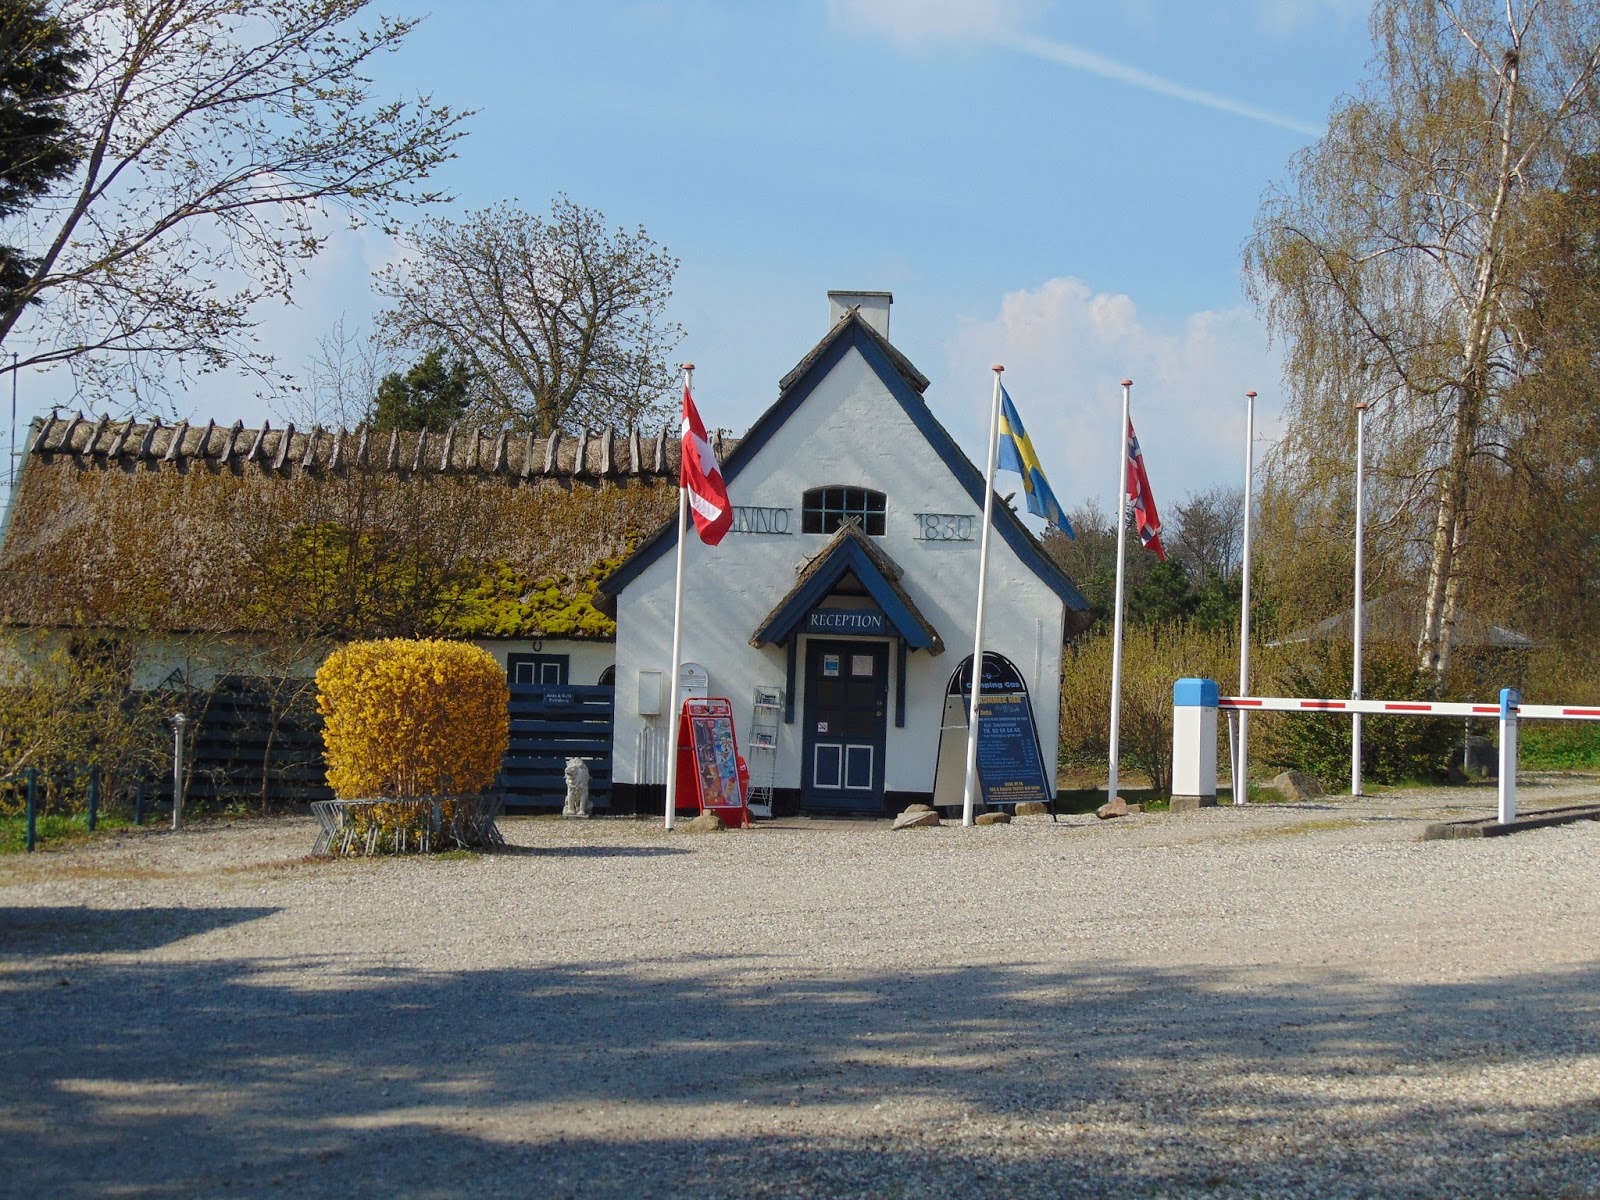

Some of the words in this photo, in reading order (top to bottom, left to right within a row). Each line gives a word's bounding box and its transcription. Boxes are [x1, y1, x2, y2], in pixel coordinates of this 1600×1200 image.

[732, 506, 792, 534] NNO
[913, 513, 975, 541] 1830
[811, 613, 881, 627] RECEPTION
